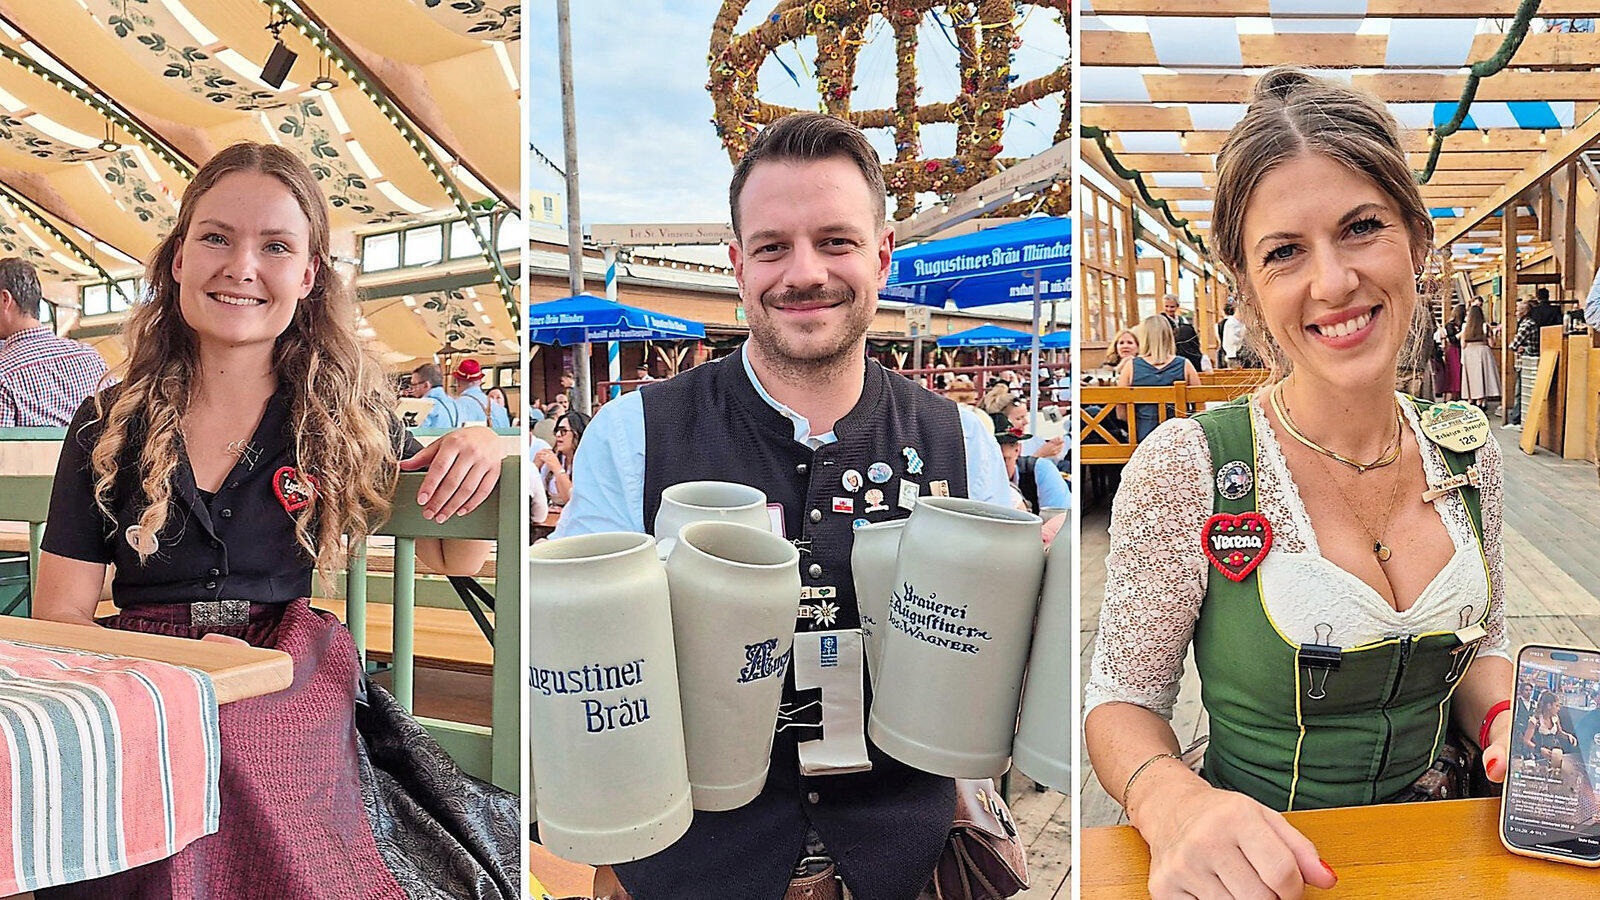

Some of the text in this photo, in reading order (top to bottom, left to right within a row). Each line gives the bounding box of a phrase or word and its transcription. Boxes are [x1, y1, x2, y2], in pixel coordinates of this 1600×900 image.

[1458, 434, 1477, 447] 126
[1210, 534, 1263, 551] Verena
[580, 696, 651, 734] Bräu
